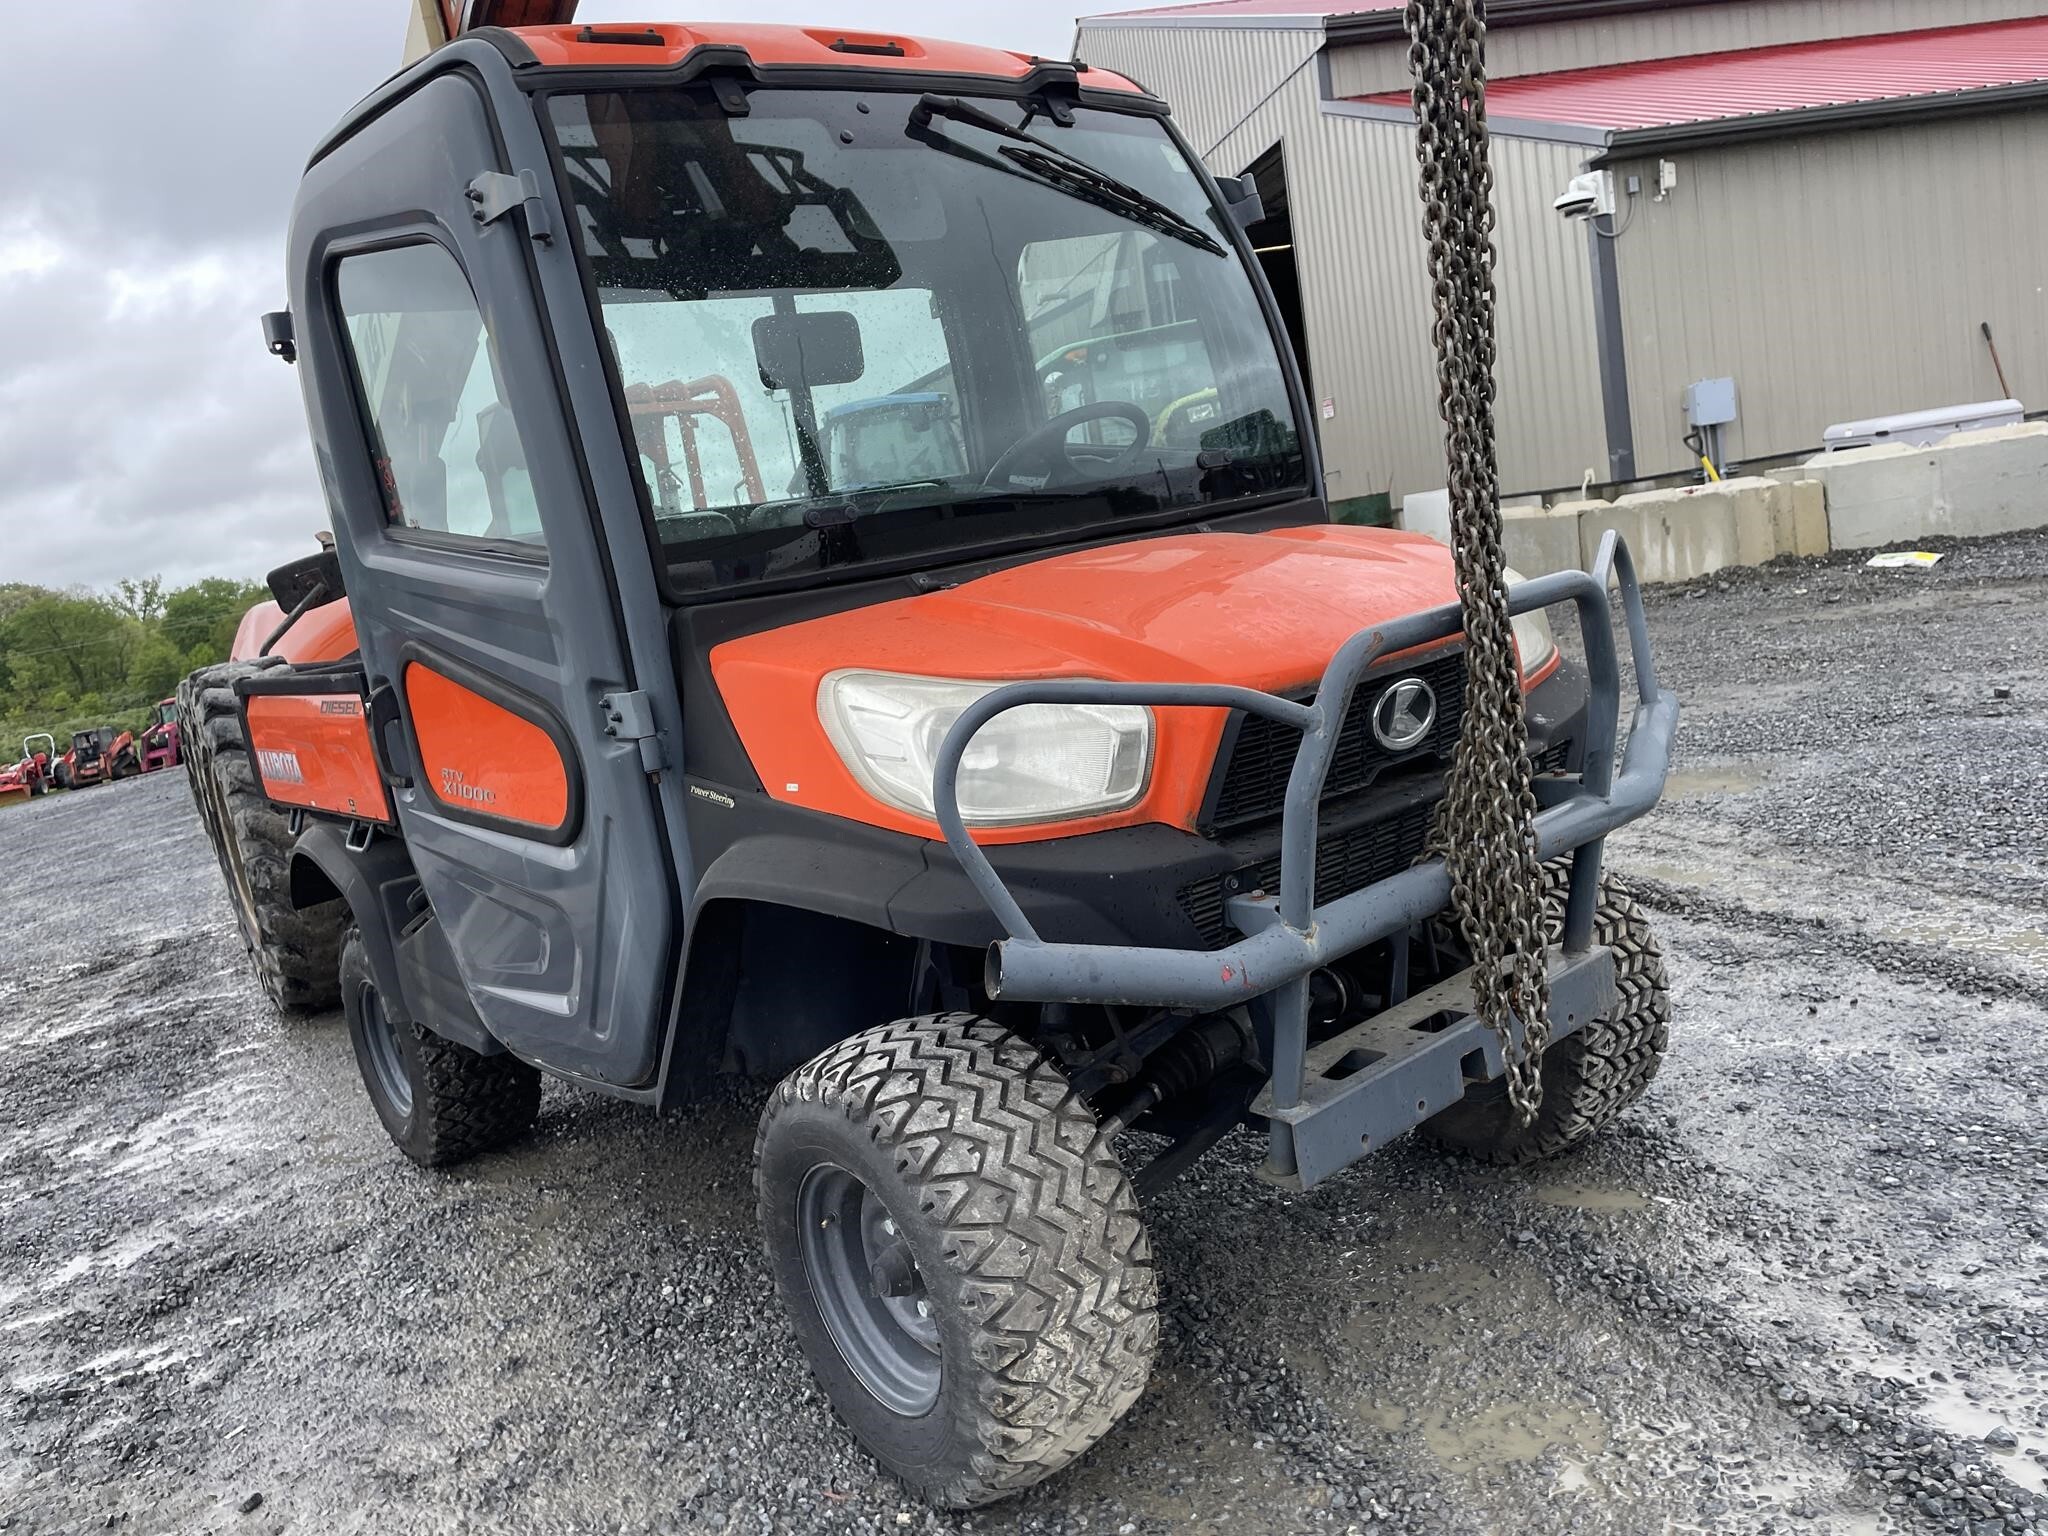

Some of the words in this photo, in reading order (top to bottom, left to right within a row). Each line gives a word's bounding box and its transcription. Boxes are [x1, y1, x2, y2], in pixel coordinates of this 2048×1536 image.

[320, 700, 360, 715] DIESEL
[441, 767, 464, 782] RTV
[690, 785, 709, 798] Power
[709, 790, 735, 809] Steering
